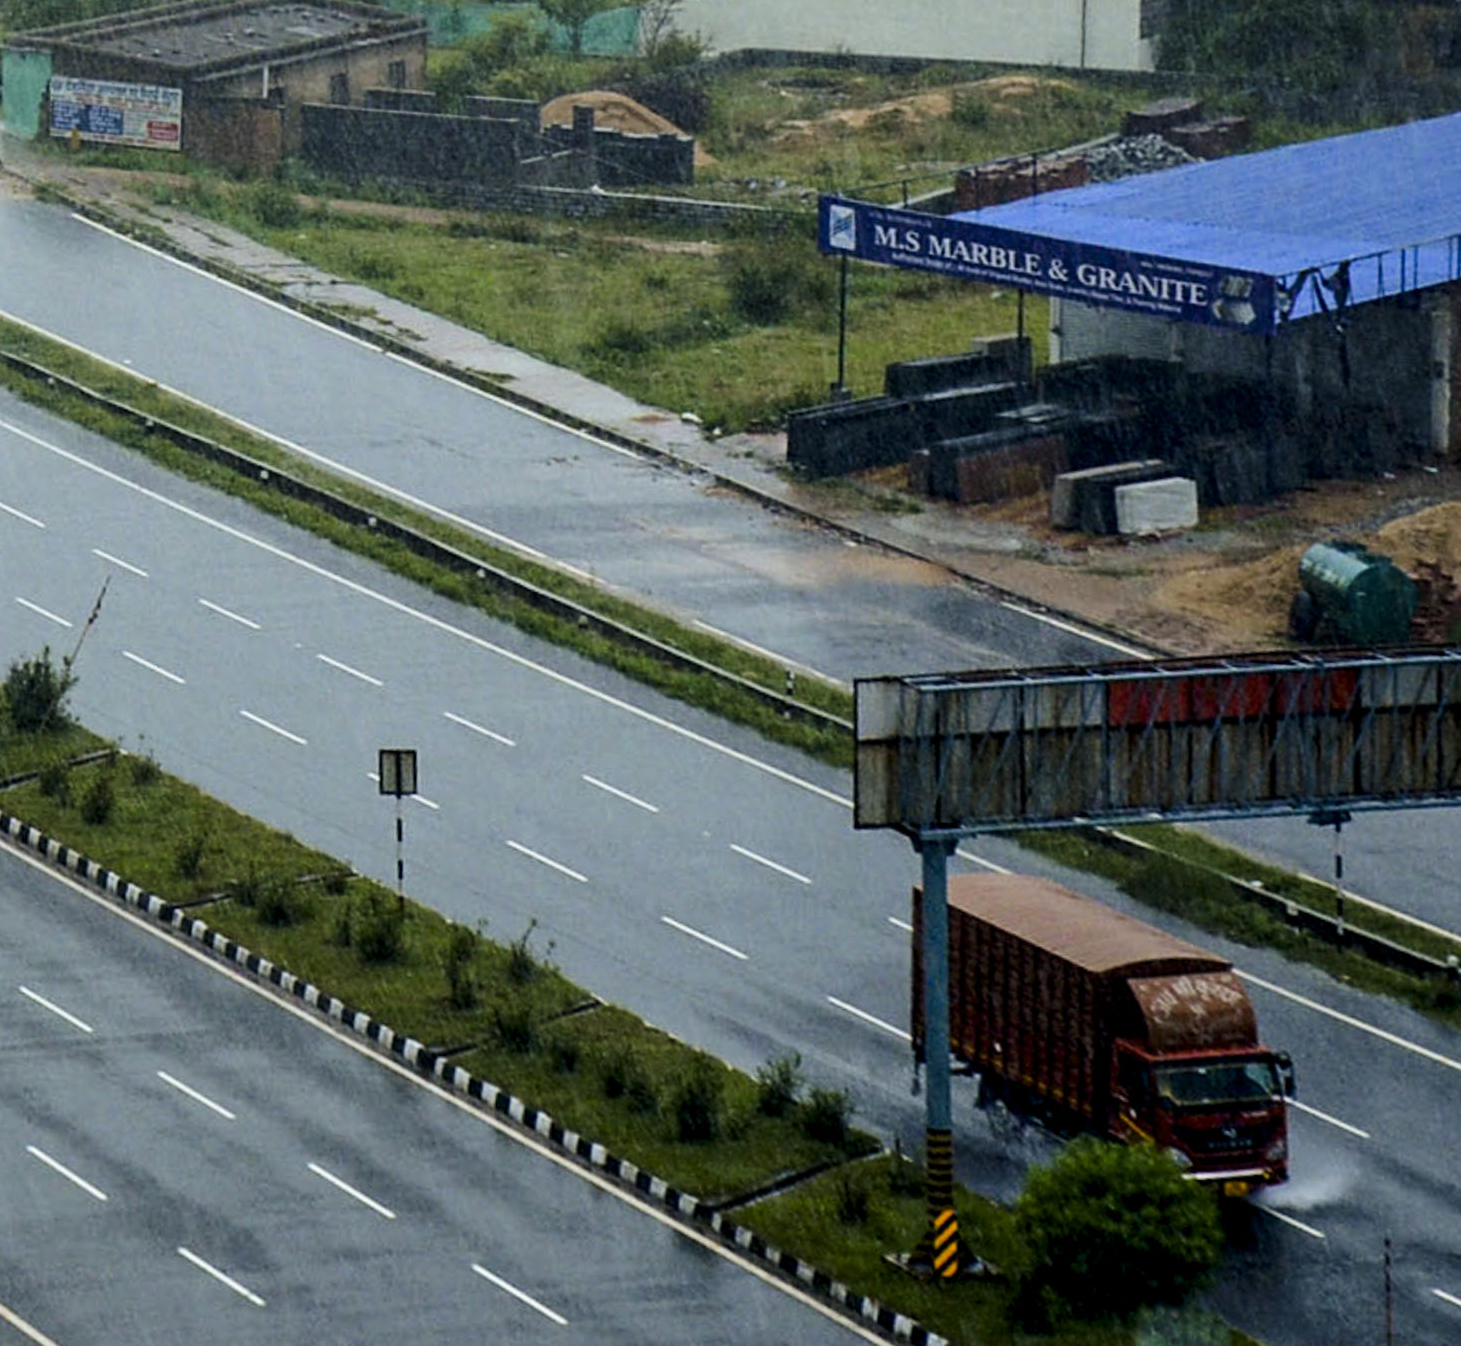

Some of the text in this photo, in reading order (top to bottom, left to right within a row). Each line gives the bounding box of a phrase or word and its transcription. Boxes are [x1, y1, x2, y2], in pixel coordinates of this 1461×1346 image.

[874, 225, 920, 253] M.S
[928, 235, 1041, 278] MARBLE
[1048, 258, 1070, 282] &
[1077, 263, 1209, 306] GRANITE
